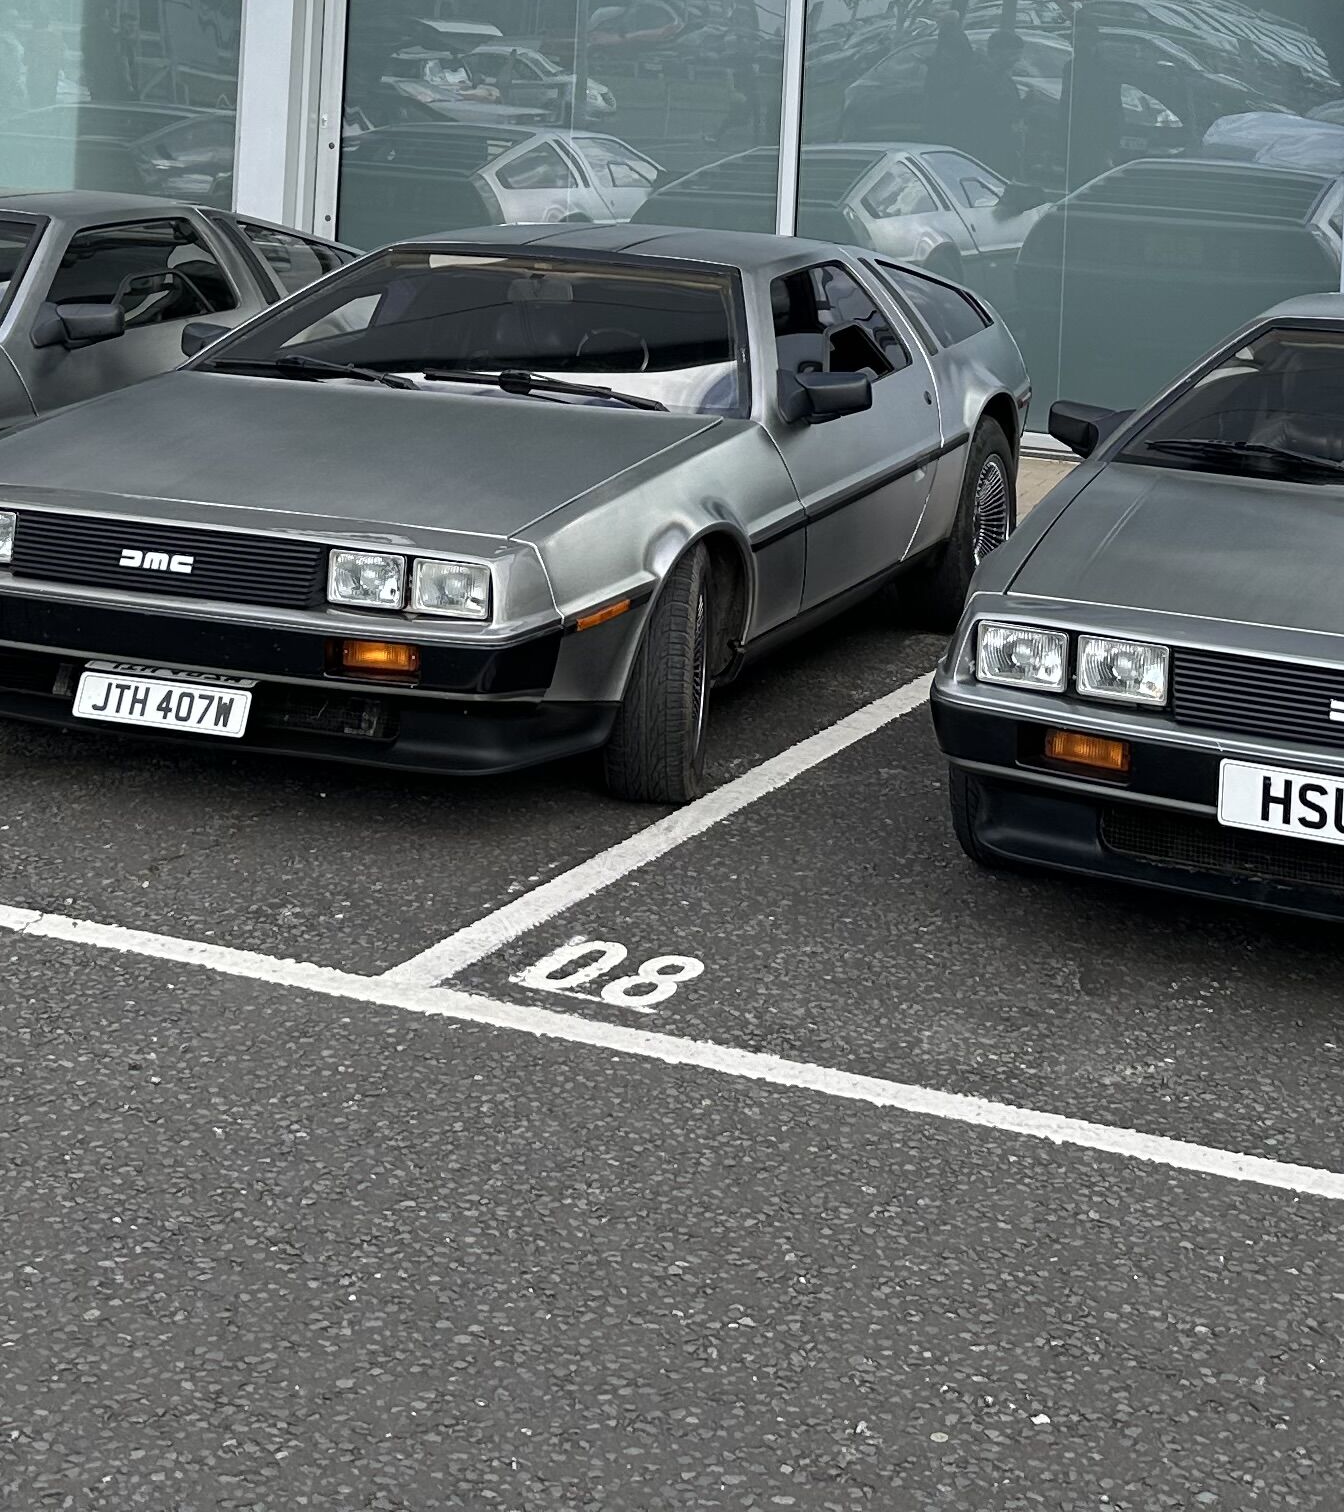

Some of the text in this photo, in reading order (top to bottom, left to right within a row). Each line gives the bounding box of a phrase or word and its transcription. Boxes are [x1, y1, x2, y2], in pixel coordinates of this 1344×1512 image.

[119, 548, 194, 574] DMC
[91, 682, 235, 728] JTH 407W
[518, 940, 705, 1008] 08
